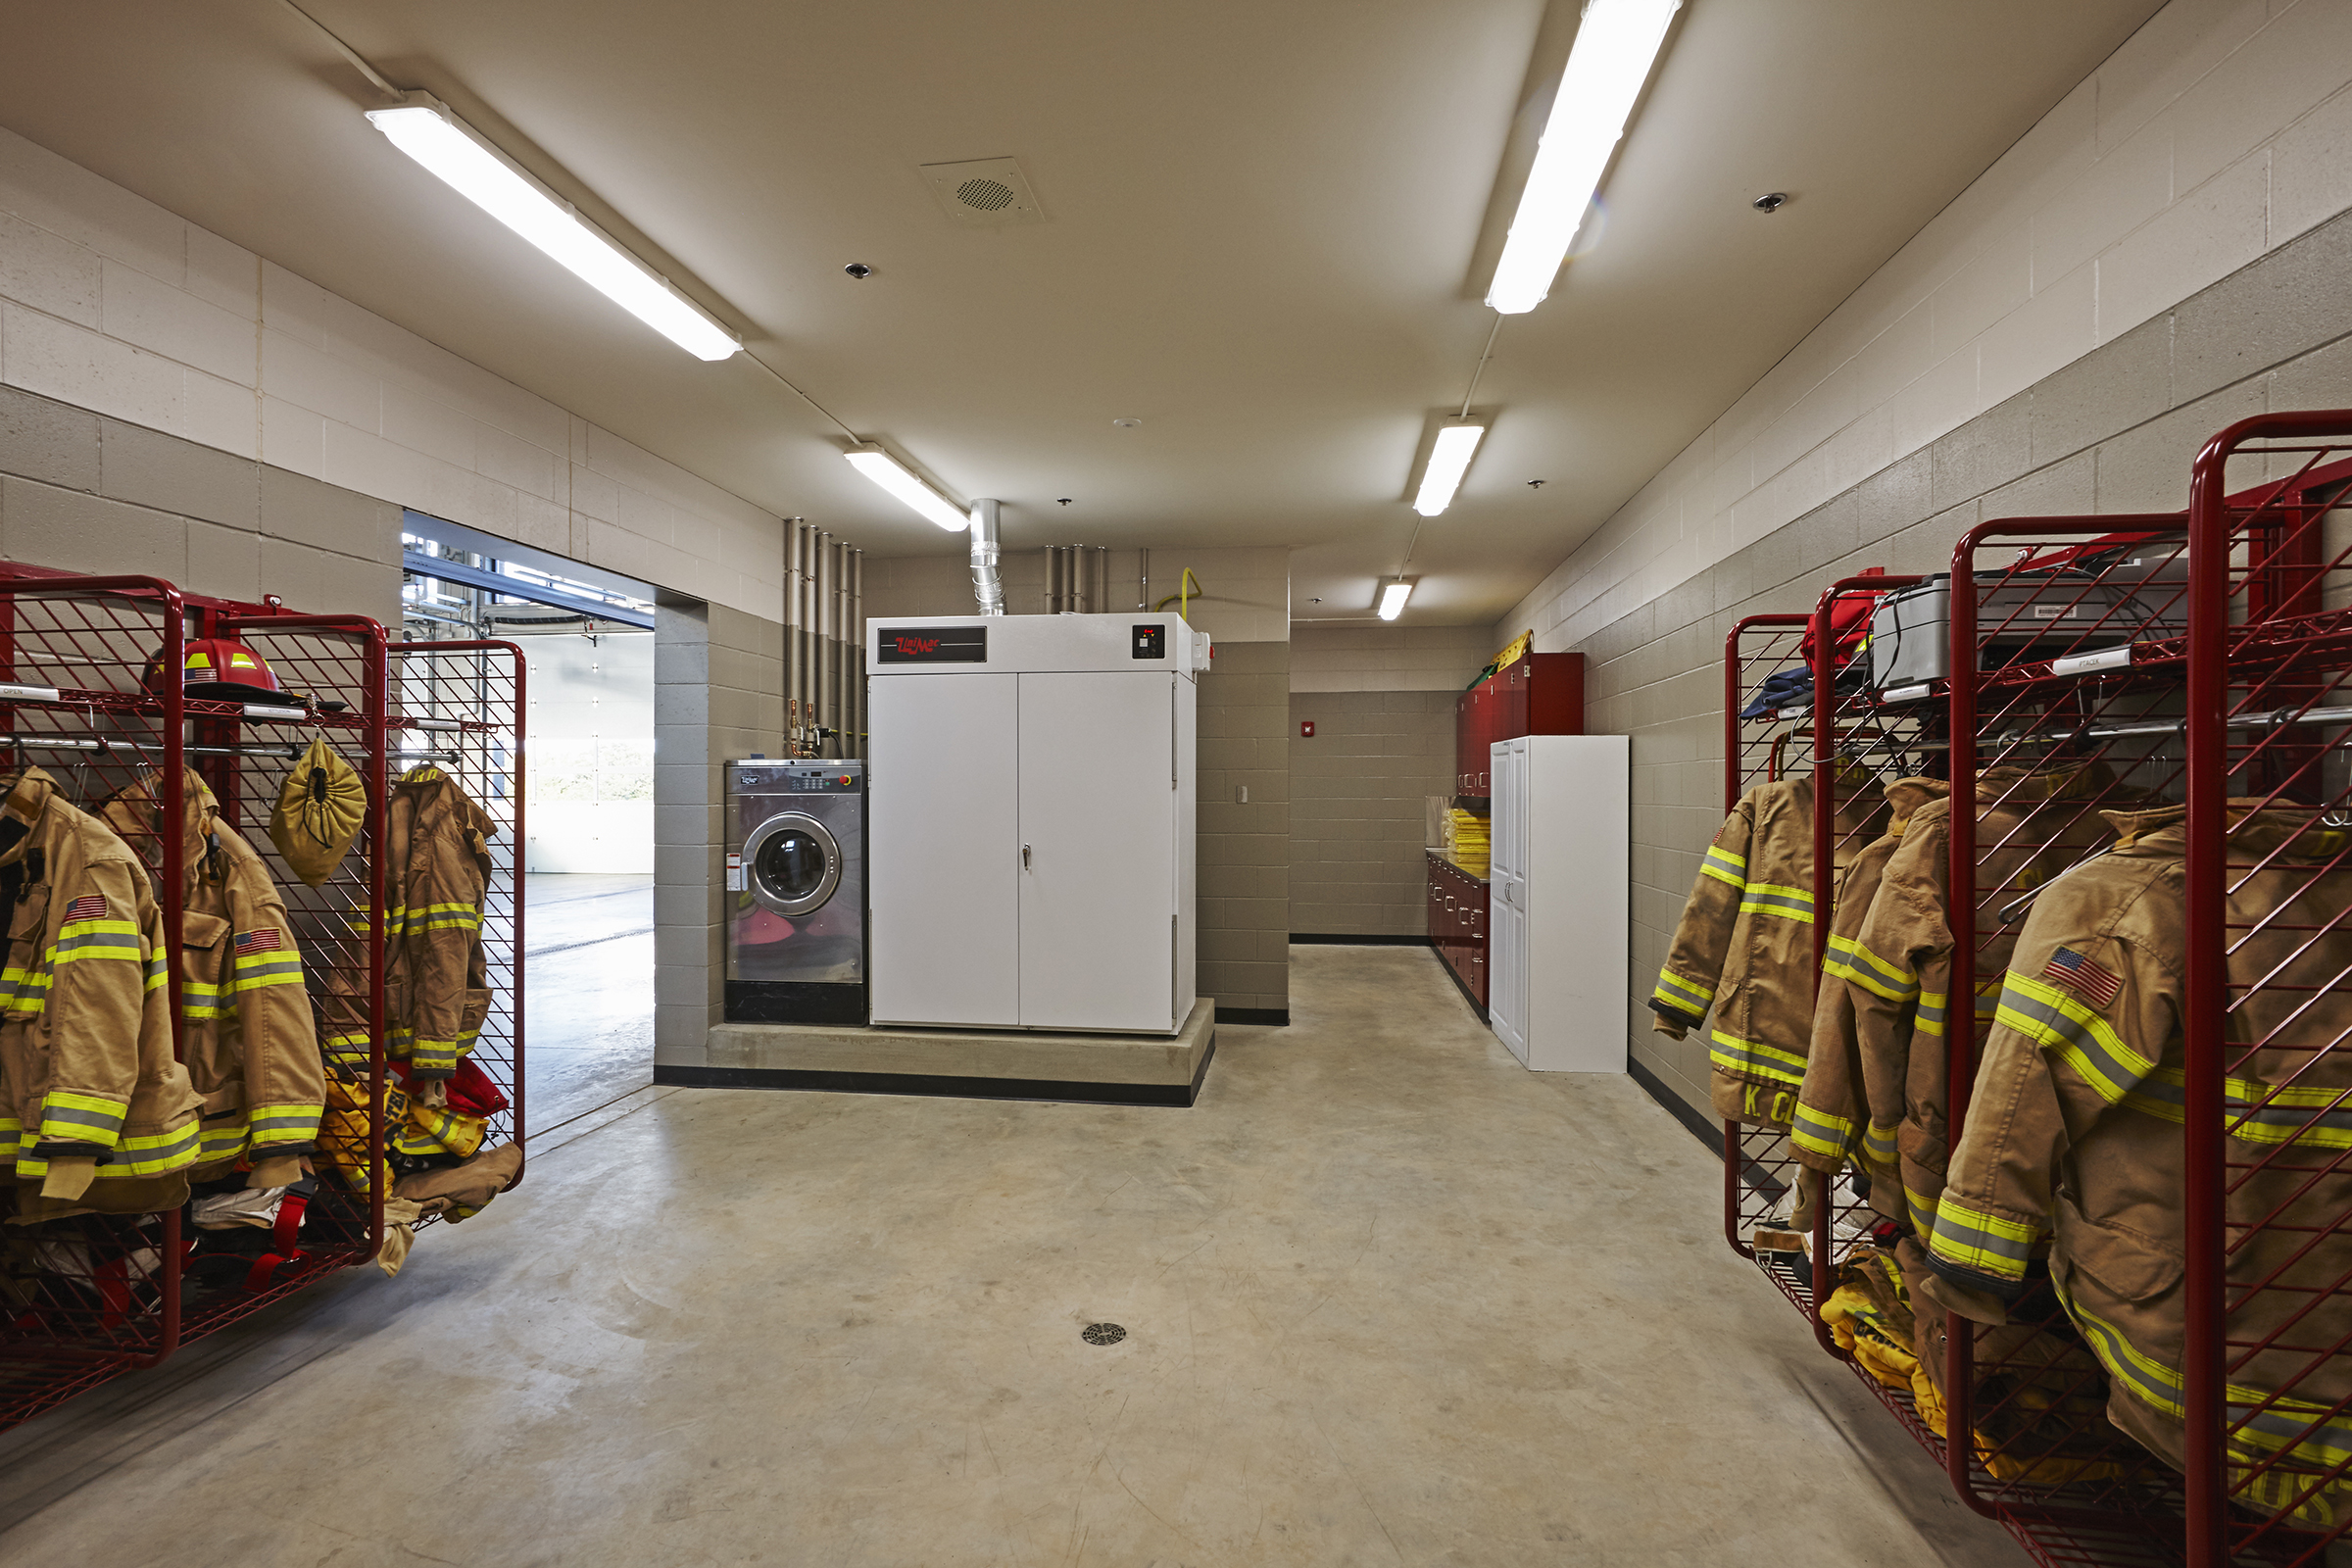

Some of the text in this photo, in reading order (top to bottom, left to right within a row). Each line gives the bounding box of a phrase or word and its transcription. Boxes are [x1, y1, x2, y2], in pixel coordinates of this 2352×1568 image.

[895, 637, 940, 656] UniMac
[2079, 658, 2100, 667] PTACEK
[1744, 1083, 1762, 1117] K.
